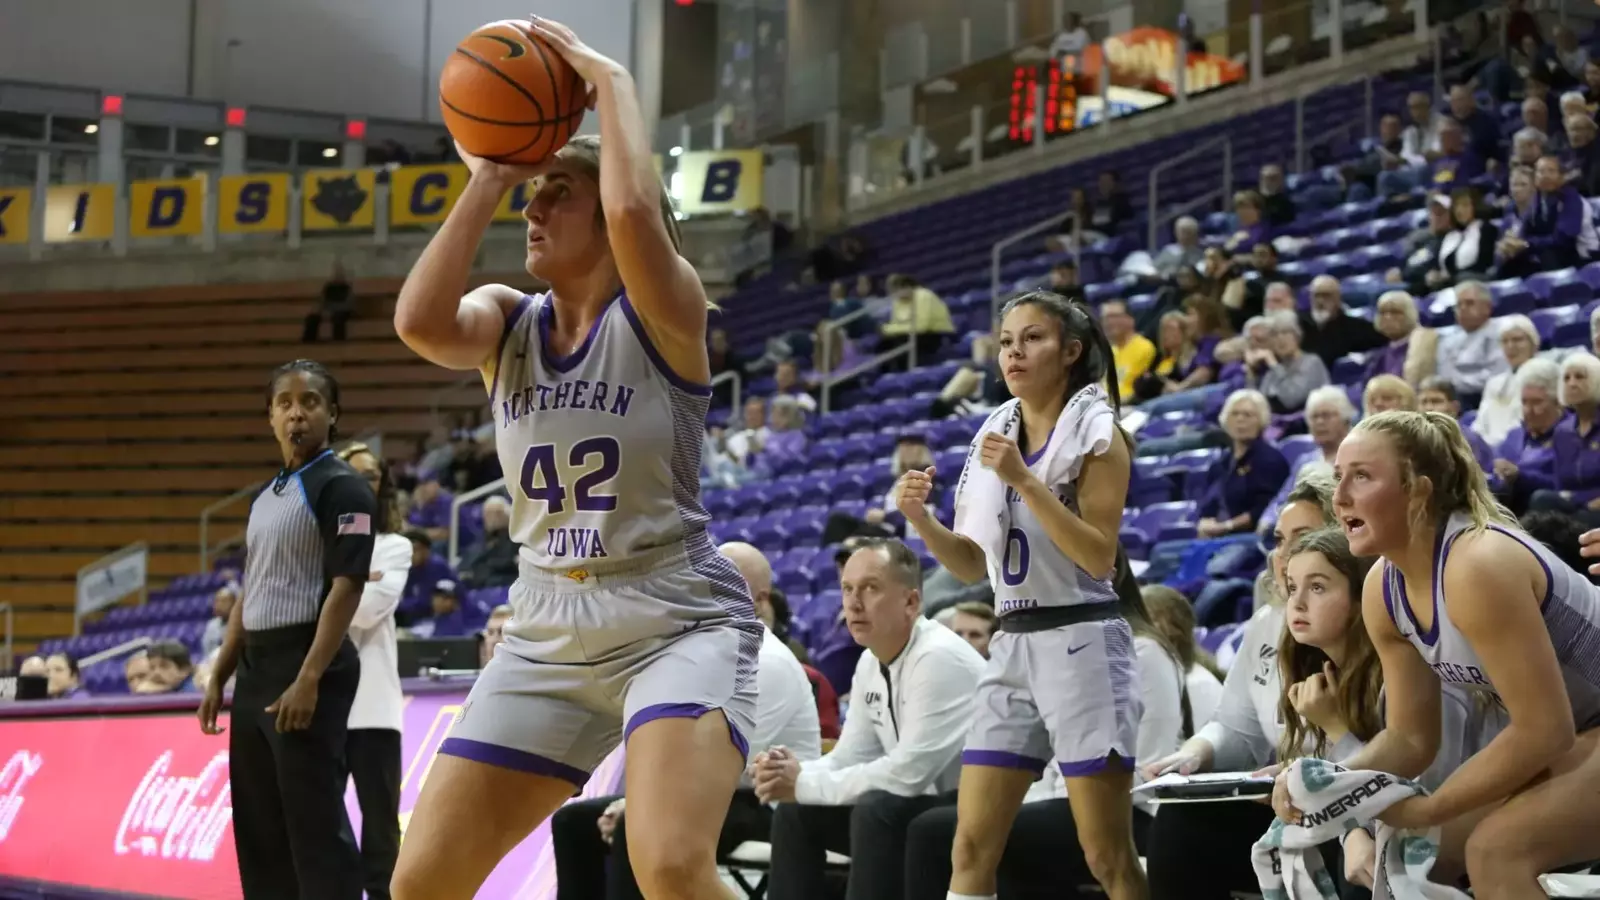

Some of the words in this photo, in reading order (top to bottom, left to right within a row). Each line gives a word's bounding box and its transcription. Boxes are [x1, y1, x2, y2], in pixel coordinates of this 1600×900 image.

[502, 380, 634, 429] NORTHERN
[519, 436, 620, 515] 42
[547, 527, 608, 558] IOWA
[1296, 773, 1393, 829] OWERADE
